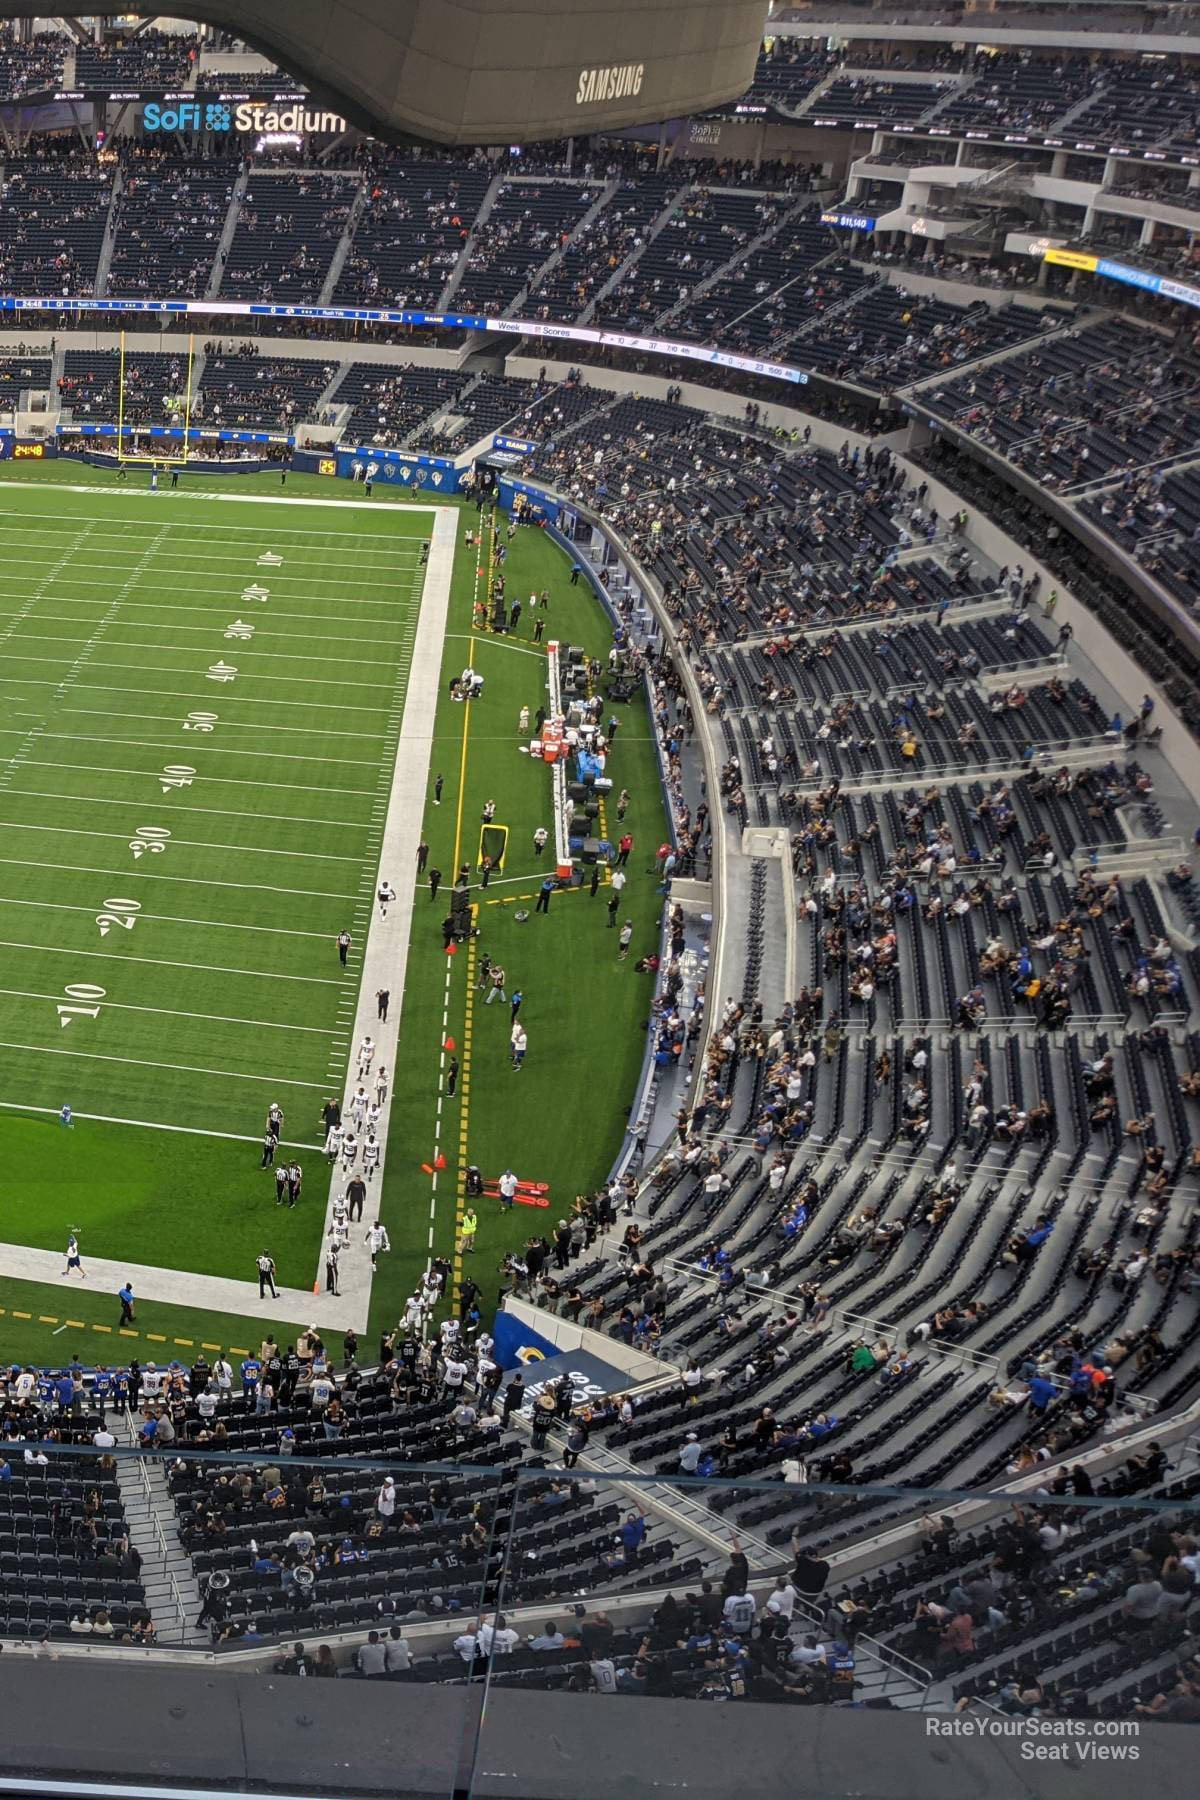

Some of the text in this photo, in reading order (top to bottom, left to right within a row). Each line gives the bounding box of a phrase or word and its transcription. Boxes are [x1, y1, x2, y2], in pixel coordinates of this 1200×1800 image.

[576, 64, 644, 104] SAMSUNG
[143, 102, 346, 133] SoFi Stadium
[841, 216, 867, 228] $11,140
[498, 322, 570, 337] Week Scores
[15, 445, 43, 456] 24:48
[506, 441, 528, 450] RAMS
[321, 461, 334, 473] 25
[256, 554, 283, 567] 10
[241, 587, 270, 602] 20
[223, 624, 255, 640] 30
[205, 665, 238, 682] 40
[182, 711, 218, 732] 50
[159, 765, 196, 787] 40
[129, 827, 171, 853] 30
[95, 898, 141, 930] 20
[57, 983, 106, 1019] 10
[245, 1369, 257, 1379] 99
[22, 1380, 28, 1389] 5
[446, 1555, 458, 1567] 15
